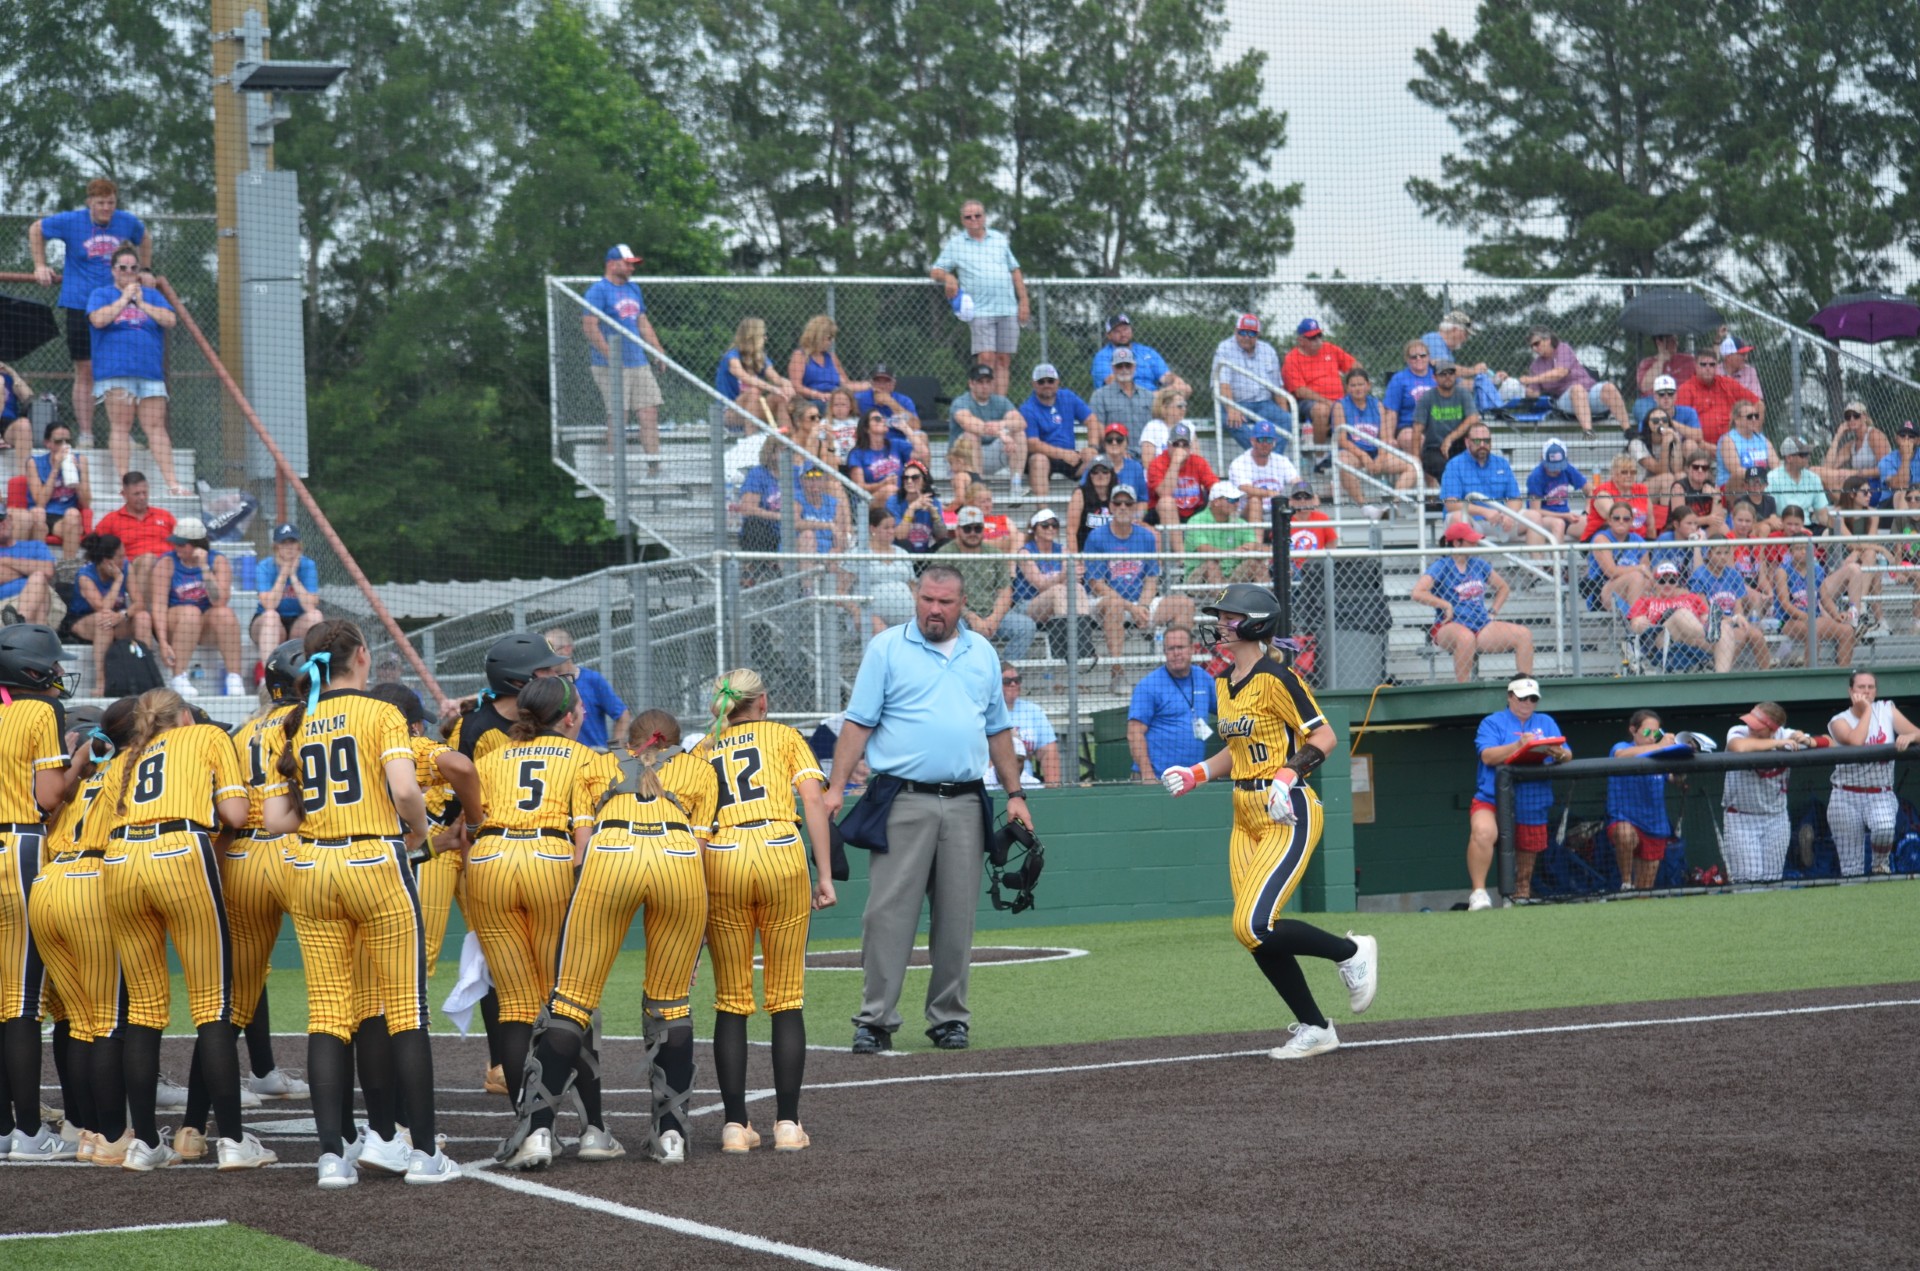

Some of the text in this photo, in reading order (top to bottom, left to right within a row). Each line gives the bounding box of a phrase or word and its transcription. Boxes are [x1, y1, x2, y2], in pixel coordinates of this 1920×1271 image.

[272, 687, 282, 699] 14
[306, 714, 346, 736] TAYLOR
[503, 746, 572, 760] ETHERIDGE
[712, 733, 755, 751] TAYLOR
[1248, 742, 1269, 764] 10
[133, 752, 167, 804] 8
[300, 735, 363, 815] 99
[516, 760, 547, 812] 5
[711, 746, 767, 810] 12
